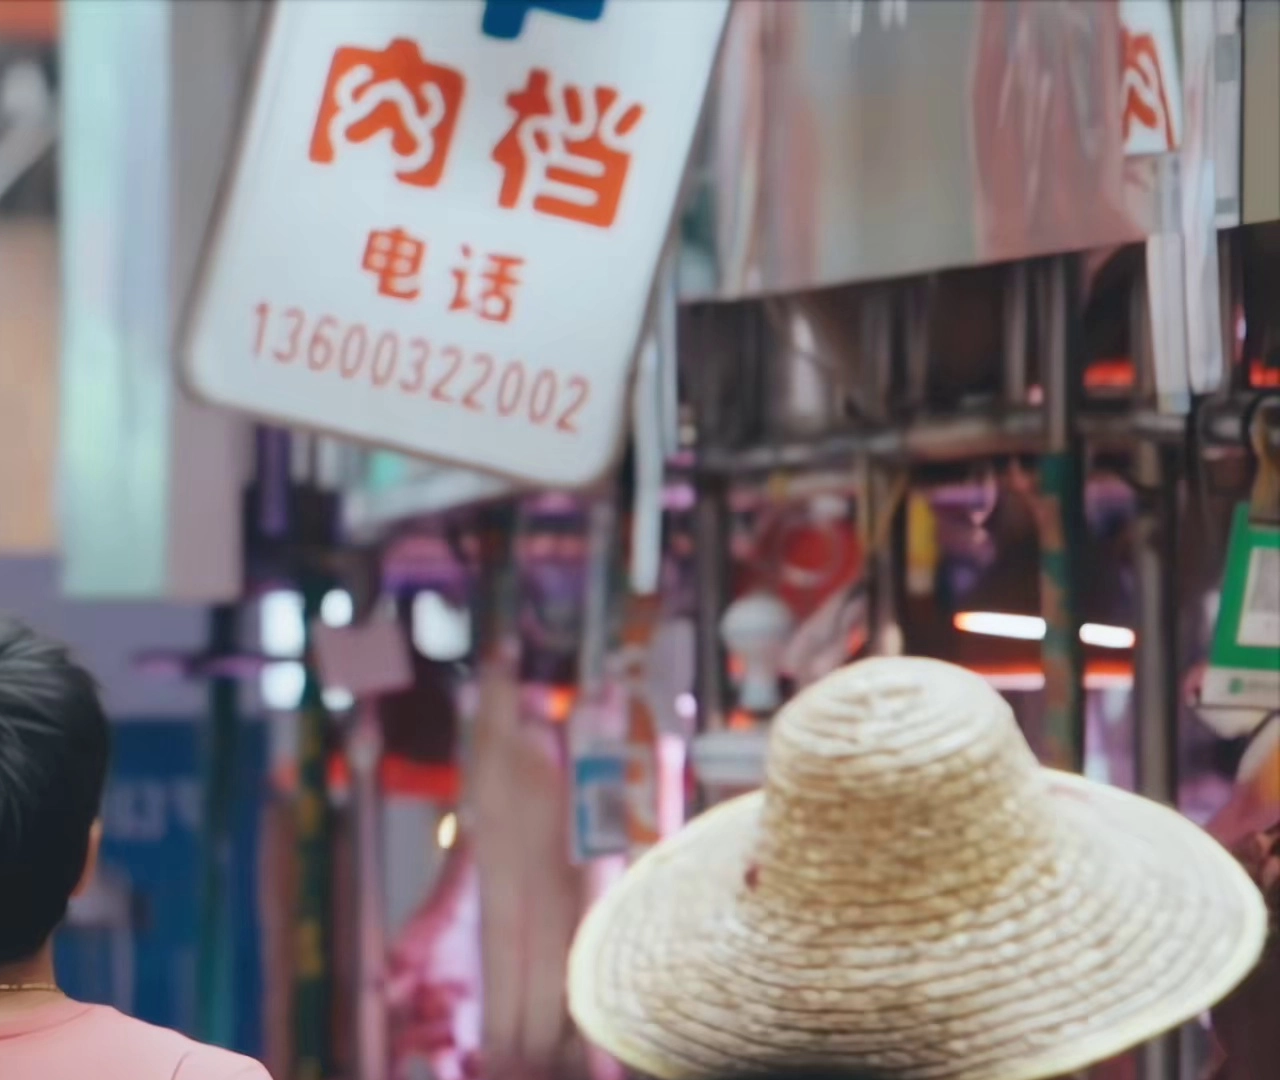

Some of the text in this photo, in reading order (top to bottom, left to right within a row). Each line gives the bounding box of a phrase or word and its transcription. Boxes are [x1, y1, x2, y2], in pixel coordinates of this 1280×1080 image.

[308, 37, 646, 229] 肉档
[361, 226, 526, 324] 电话
[251, 300, 593, 434] 13600322002
